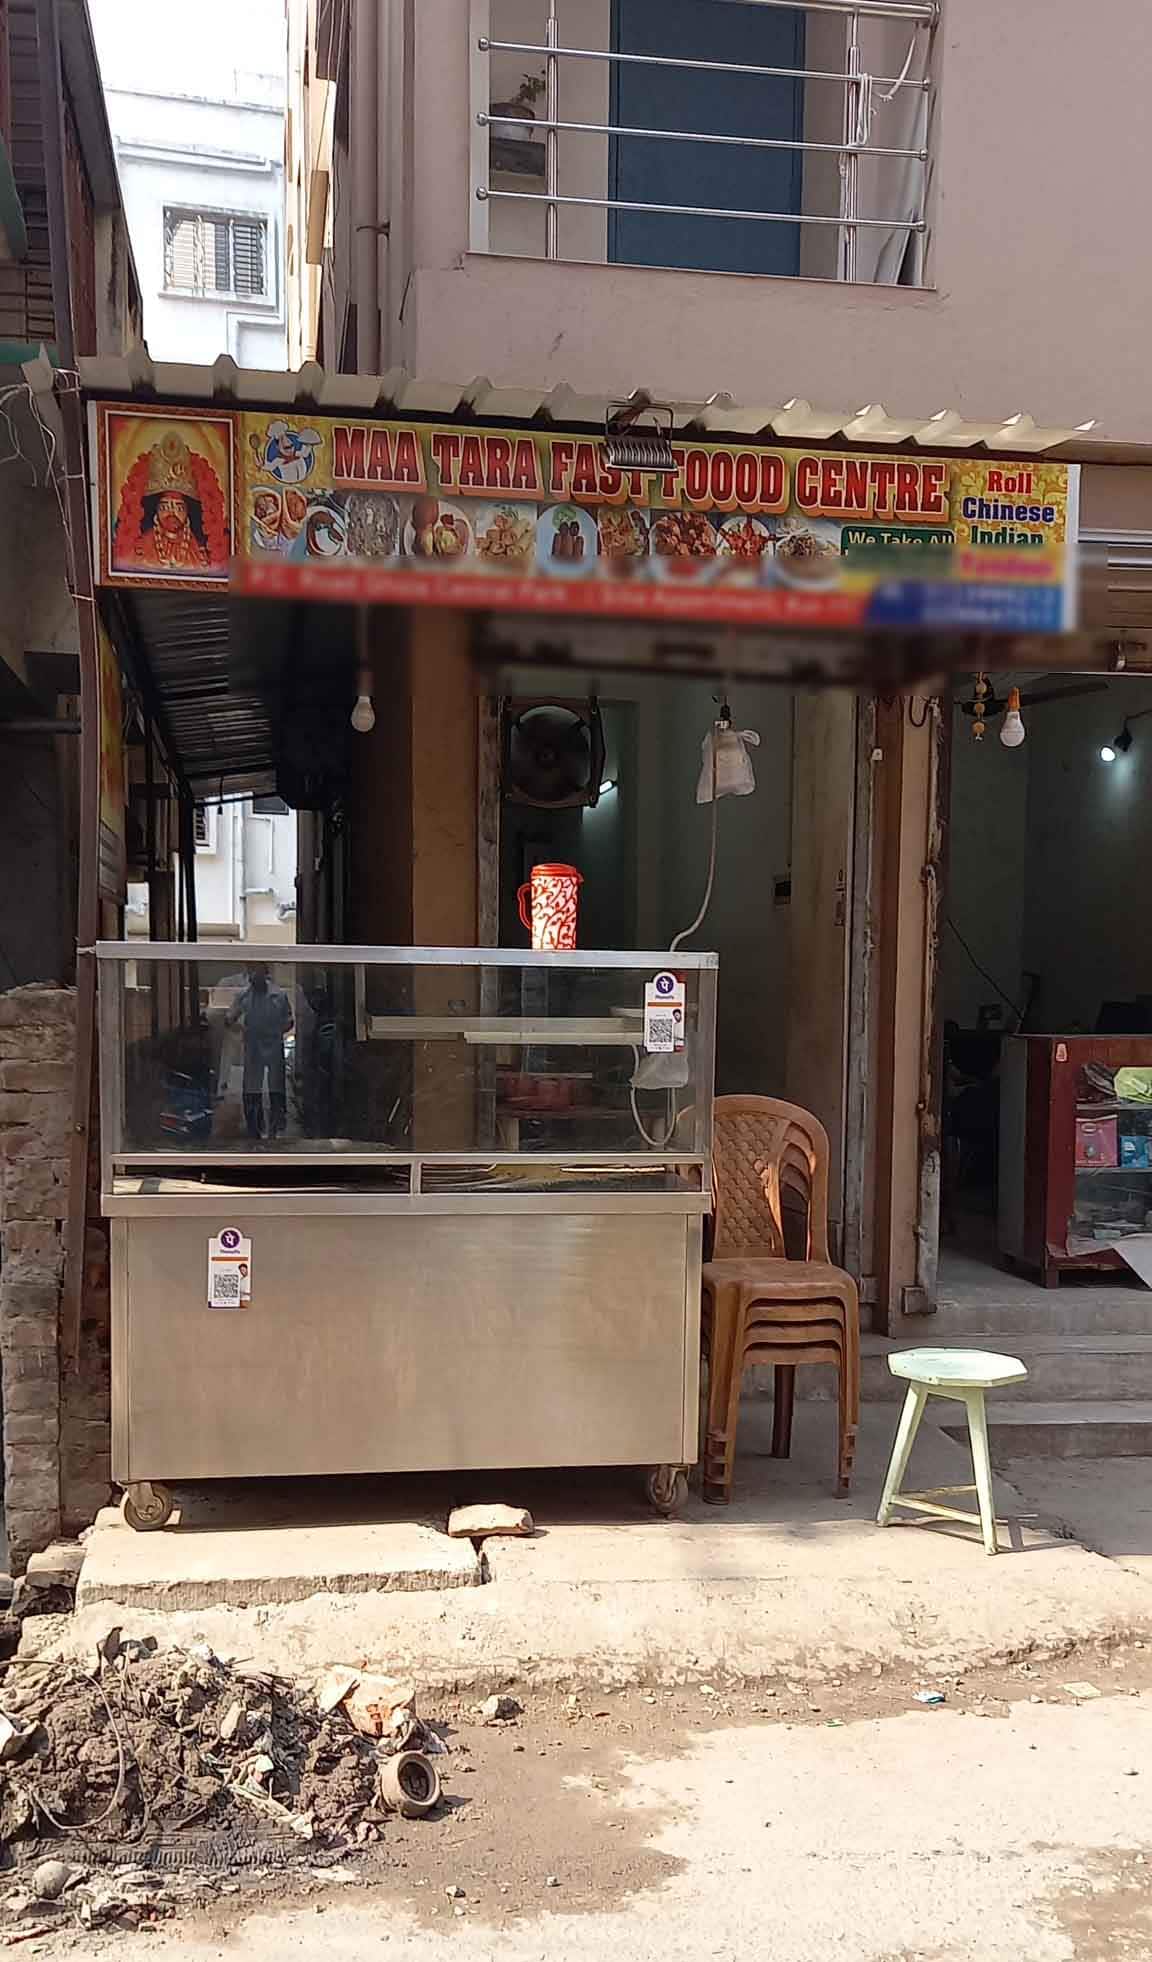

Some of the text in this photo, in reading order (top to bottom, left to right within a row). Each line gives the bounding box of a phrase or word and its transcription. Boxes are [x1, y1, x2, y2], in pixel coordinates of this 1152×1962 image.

[332, 426, 422, 486] MAA
[431, 432, 542, 491] TARA
[661, 448, 785, 507] FOOOD
[795, 456, 947, 515] CENTRE
[987, 469, 1033, 495] Roll
[962, 496, 1056, 523] Chinese
[848, 531, 876, 544] We
[880, 533, 922, 544] Take
[970, 525, 1044, 545] Indian
